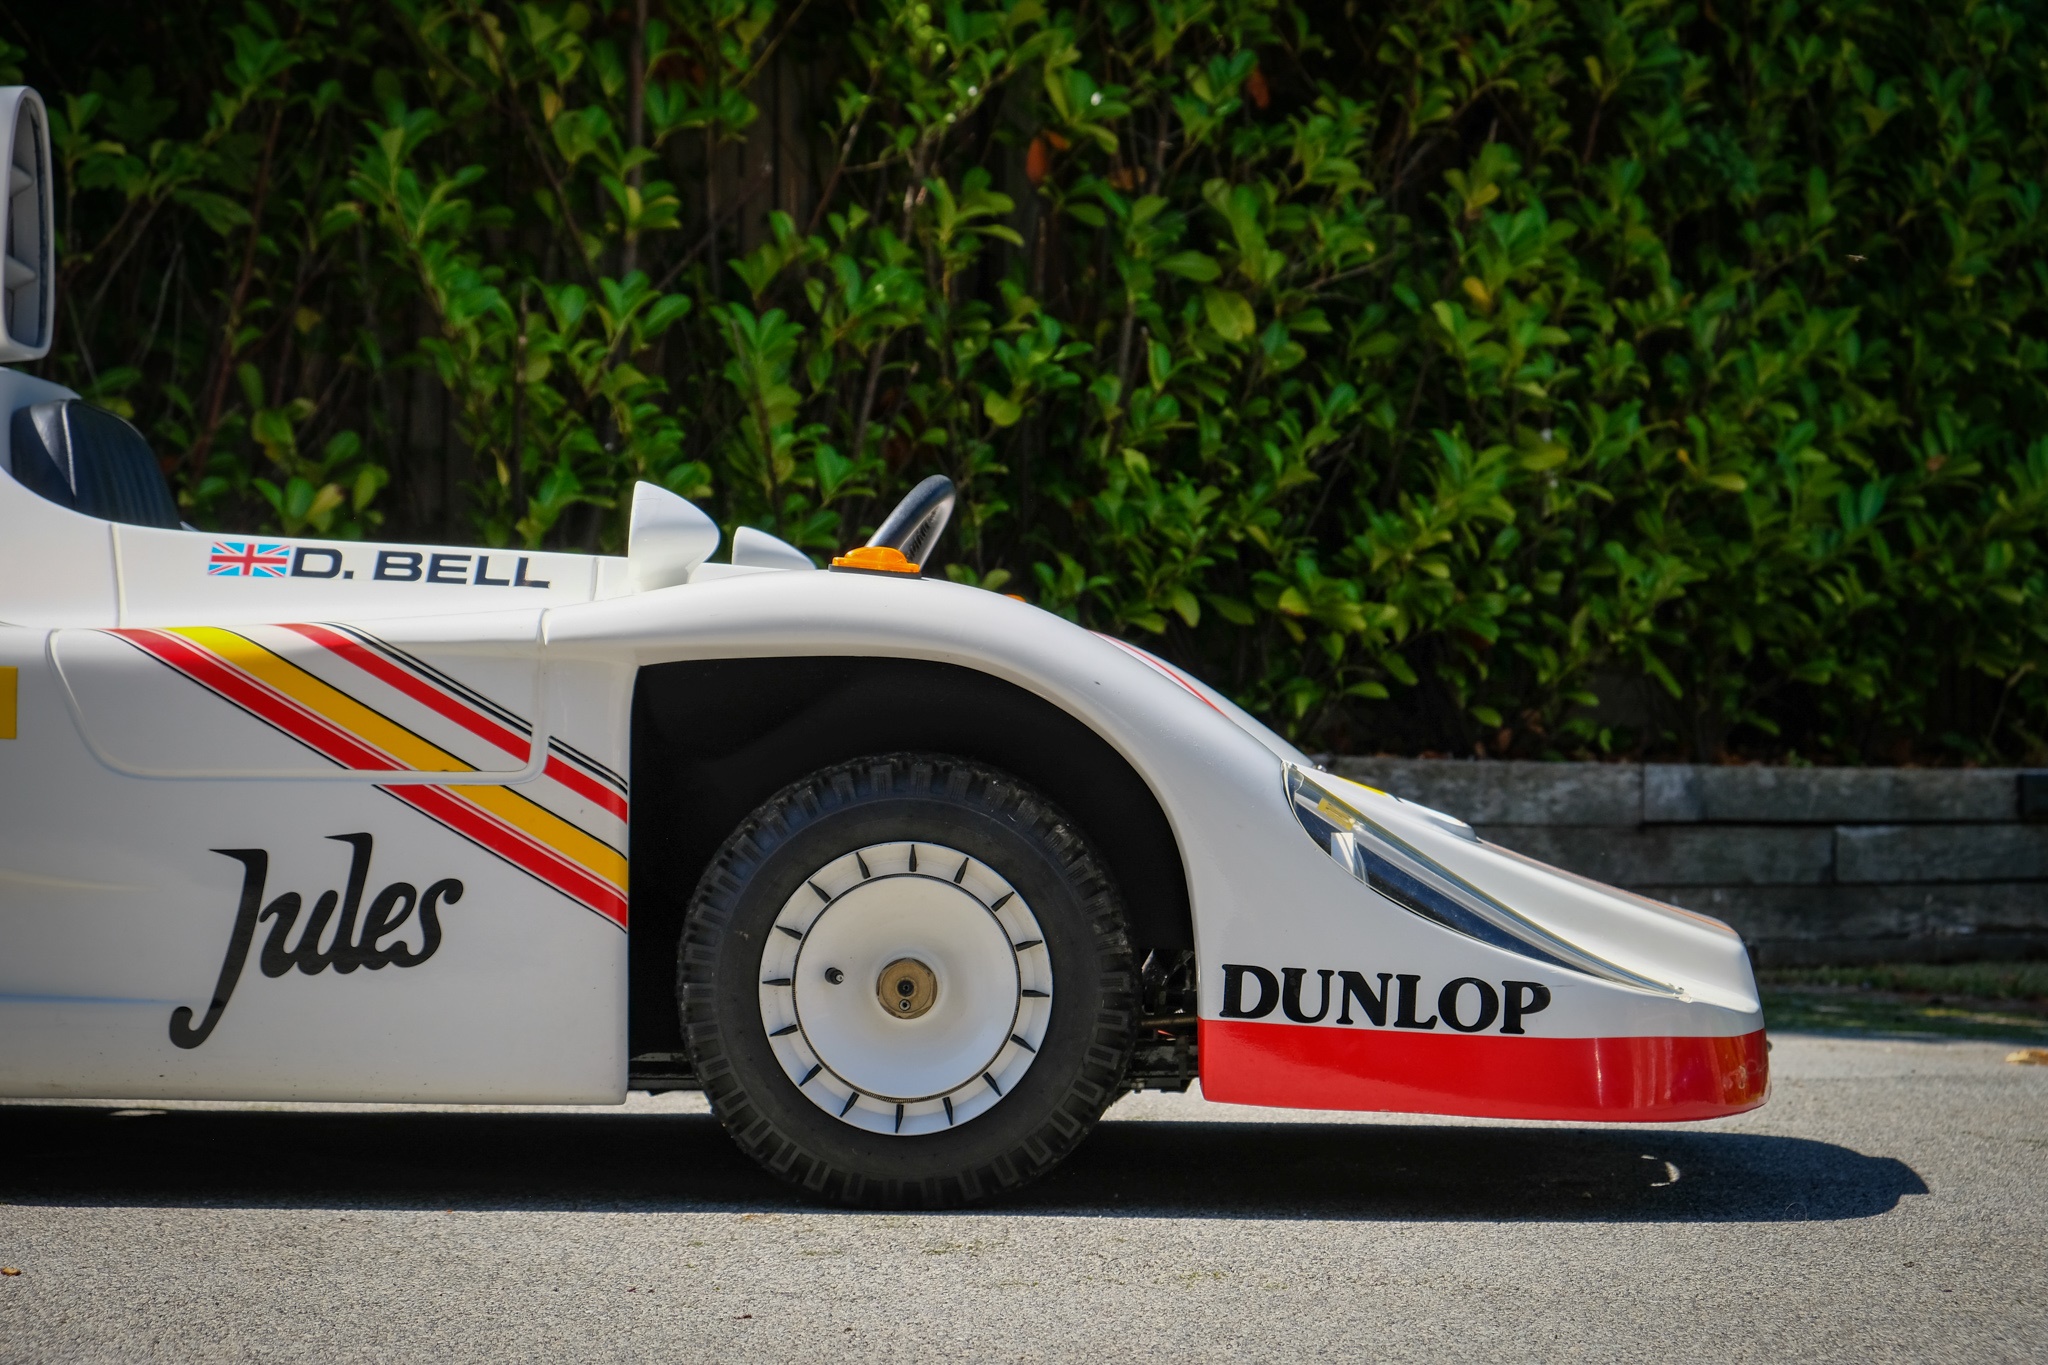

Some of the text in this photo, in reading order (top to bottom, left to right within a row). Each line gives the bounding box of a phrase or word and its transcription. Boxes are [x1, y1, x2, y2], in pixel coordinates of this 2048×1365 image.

[291, 547, 551, 589] D. BELL
[169, 832, 464, 1050] Jules
[1219, 964, 1551, 1035] DUNLOP
